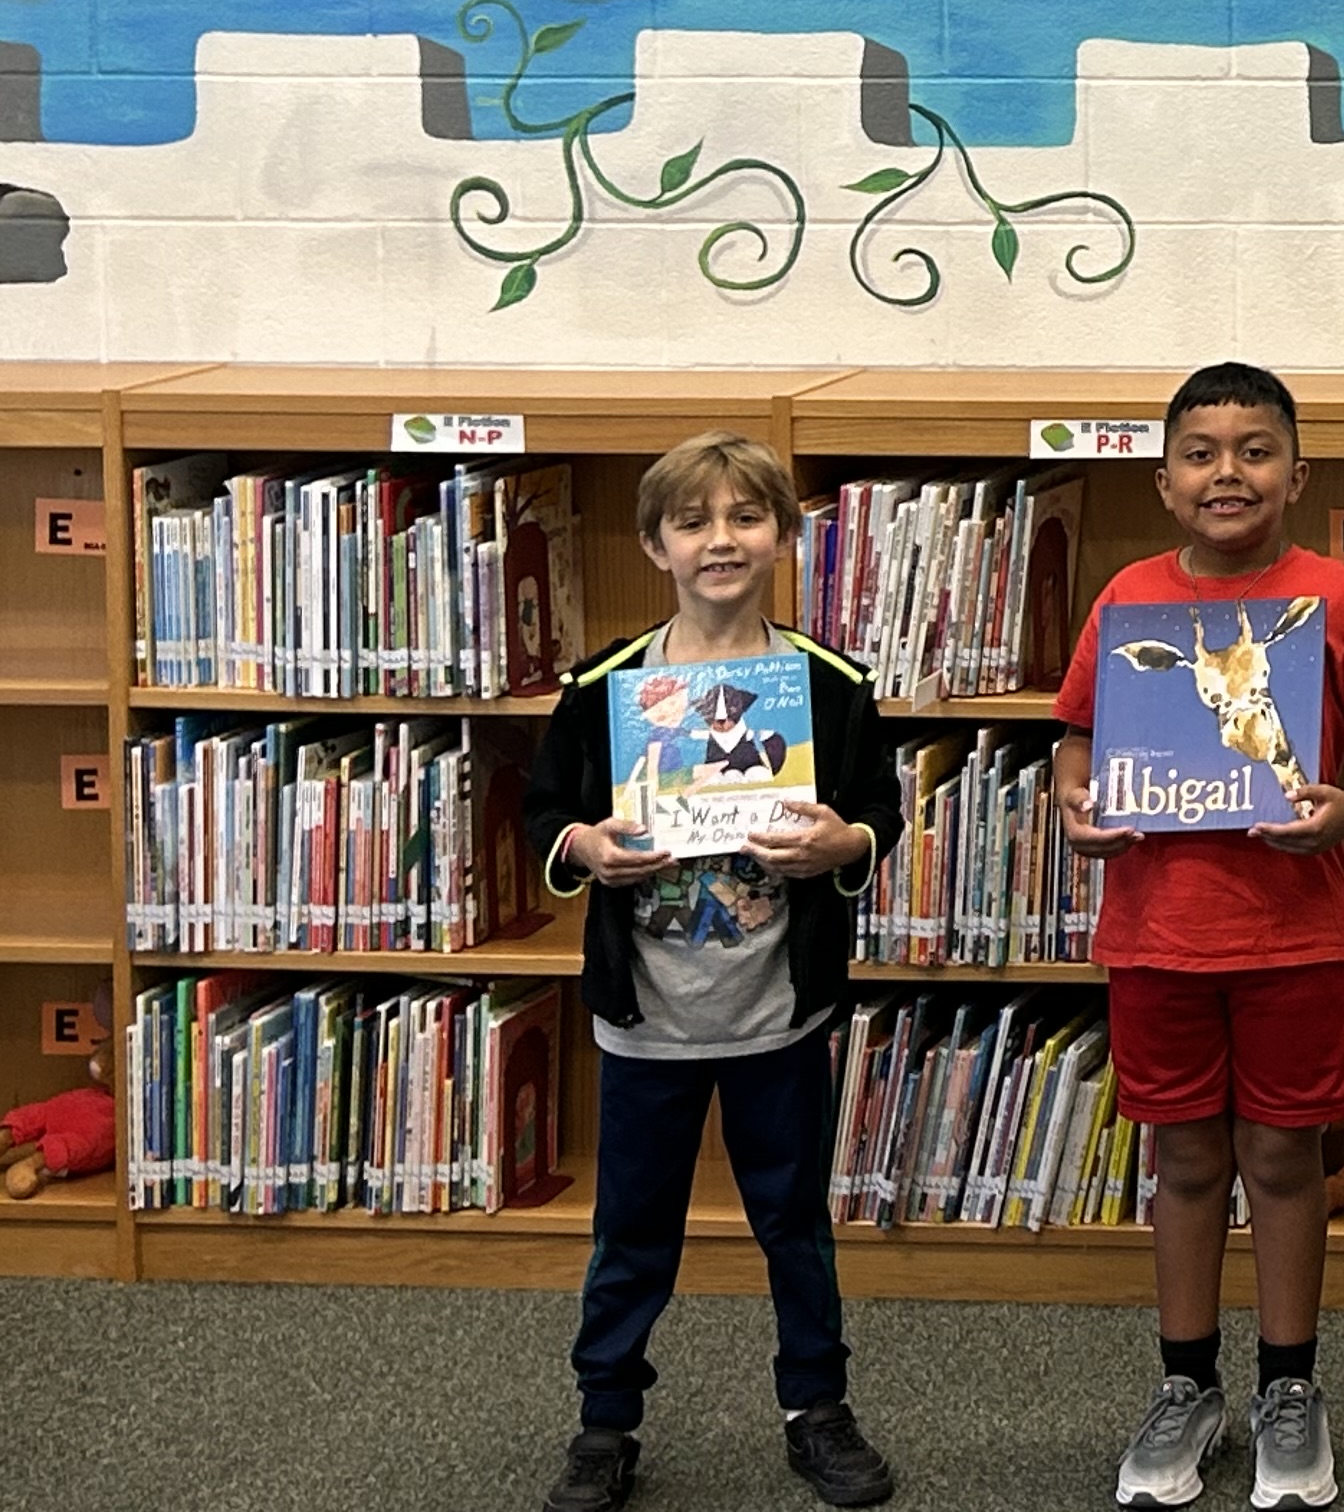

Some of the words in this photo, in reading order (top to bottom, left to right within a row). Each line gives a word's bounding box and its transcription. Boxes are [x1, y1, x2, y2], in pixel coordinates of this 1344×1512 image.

[459, 416, 511, 427] Fiction
[1096, 423, 1149, 433] Fiction
[459, 429, 502, 445] N-P
[1096, 434, 1133, 453] P-R
[49, 512, 72, 546] E
[75, 768, 99, 802] E
[670, 809, 682, 827] I
[691, 803, 740, 826] Want
[750, 811, 759, 825] a
[55, 1008, 79, 1042] E
